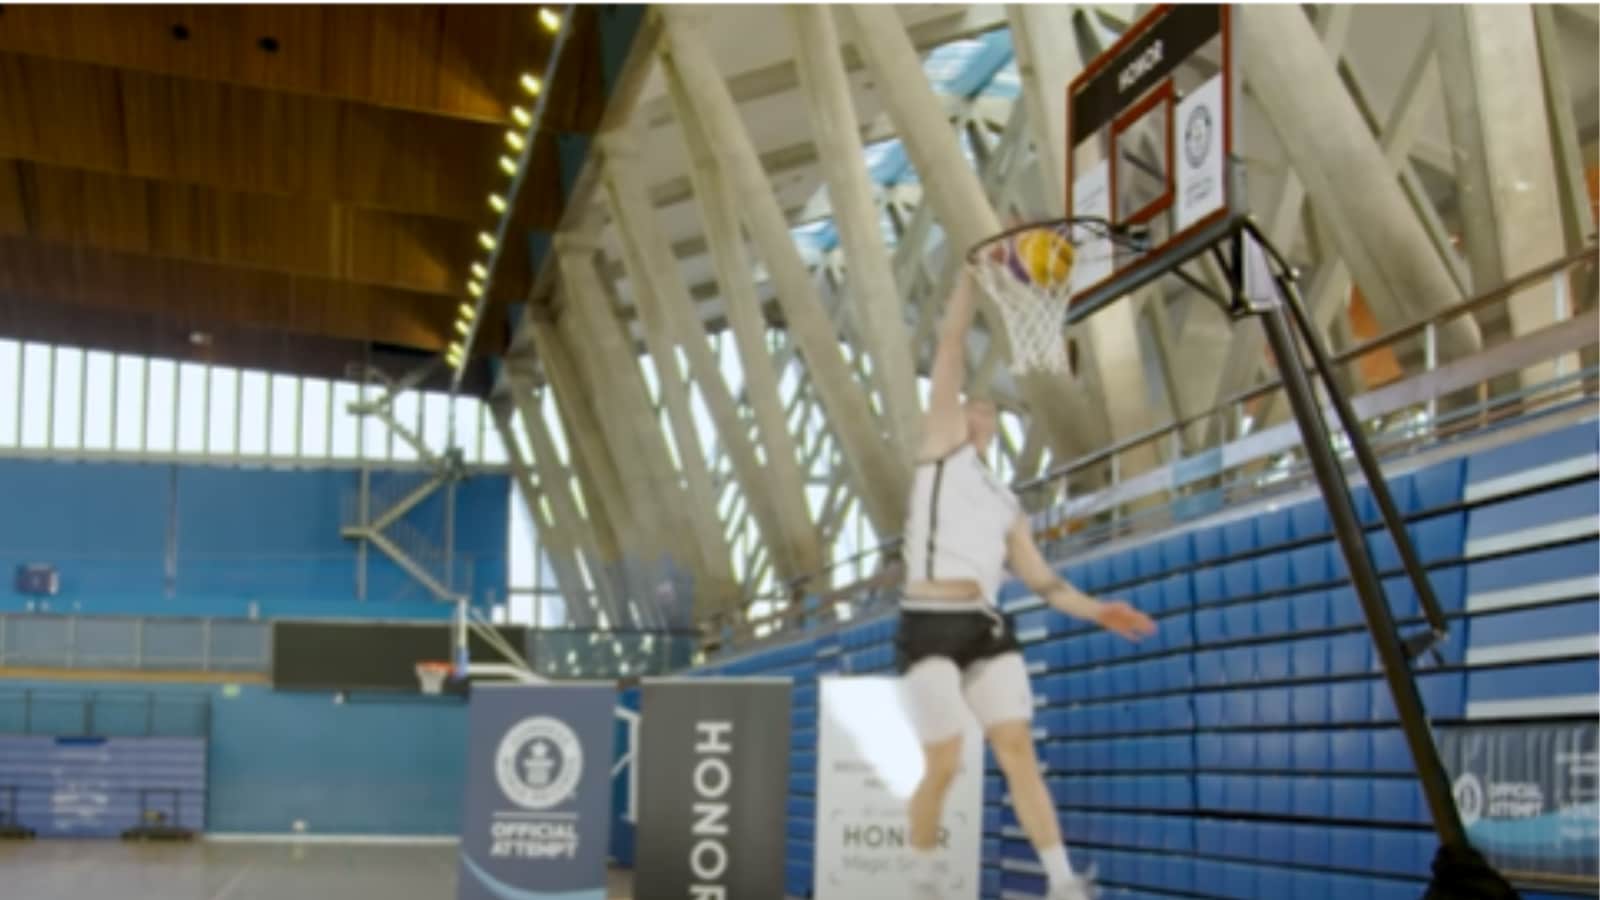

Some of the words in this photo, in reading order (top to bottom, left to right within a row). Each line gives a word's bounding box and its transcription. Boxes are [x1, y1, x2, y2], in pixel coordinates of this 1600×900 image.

[1117, 39, 1163, 93] HONOR
[491, 822, 577, 840] OFFICIAL
[842, 824, 951, 848] HONR
[490, 840, 578, 859] ATTEMPT
